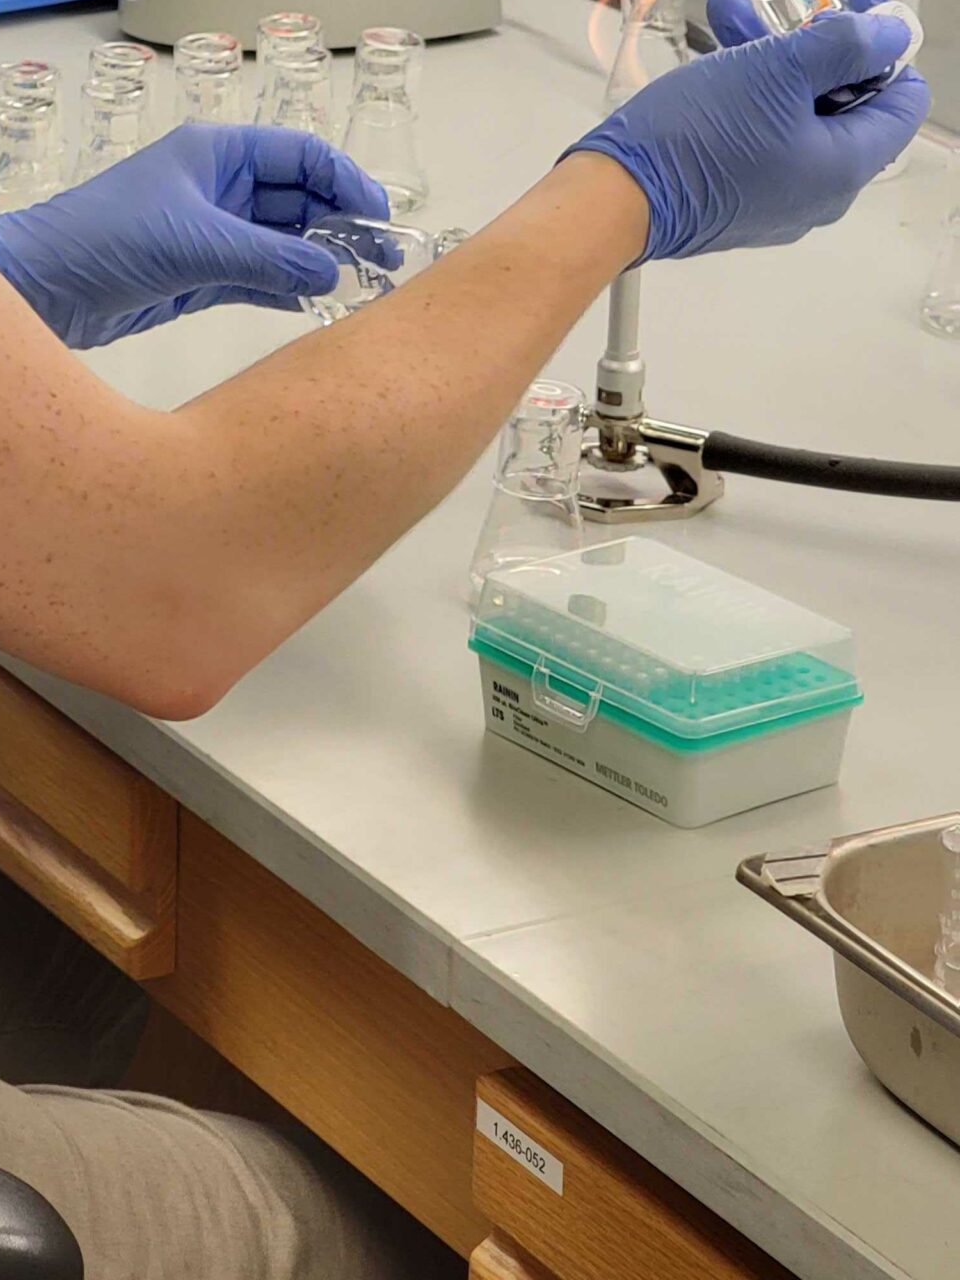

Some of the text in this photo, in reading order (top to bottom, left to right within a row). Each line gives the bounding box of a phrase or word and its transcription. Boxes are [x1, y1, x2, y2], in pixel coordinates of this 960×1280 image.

[492, 680, 519, 704] RAININ
[491, 706, 505, 721] LTS
[595, 761, 669, 808] METTLER TOLEDO
[493, 1121, 546, 1175] 1.436-052
